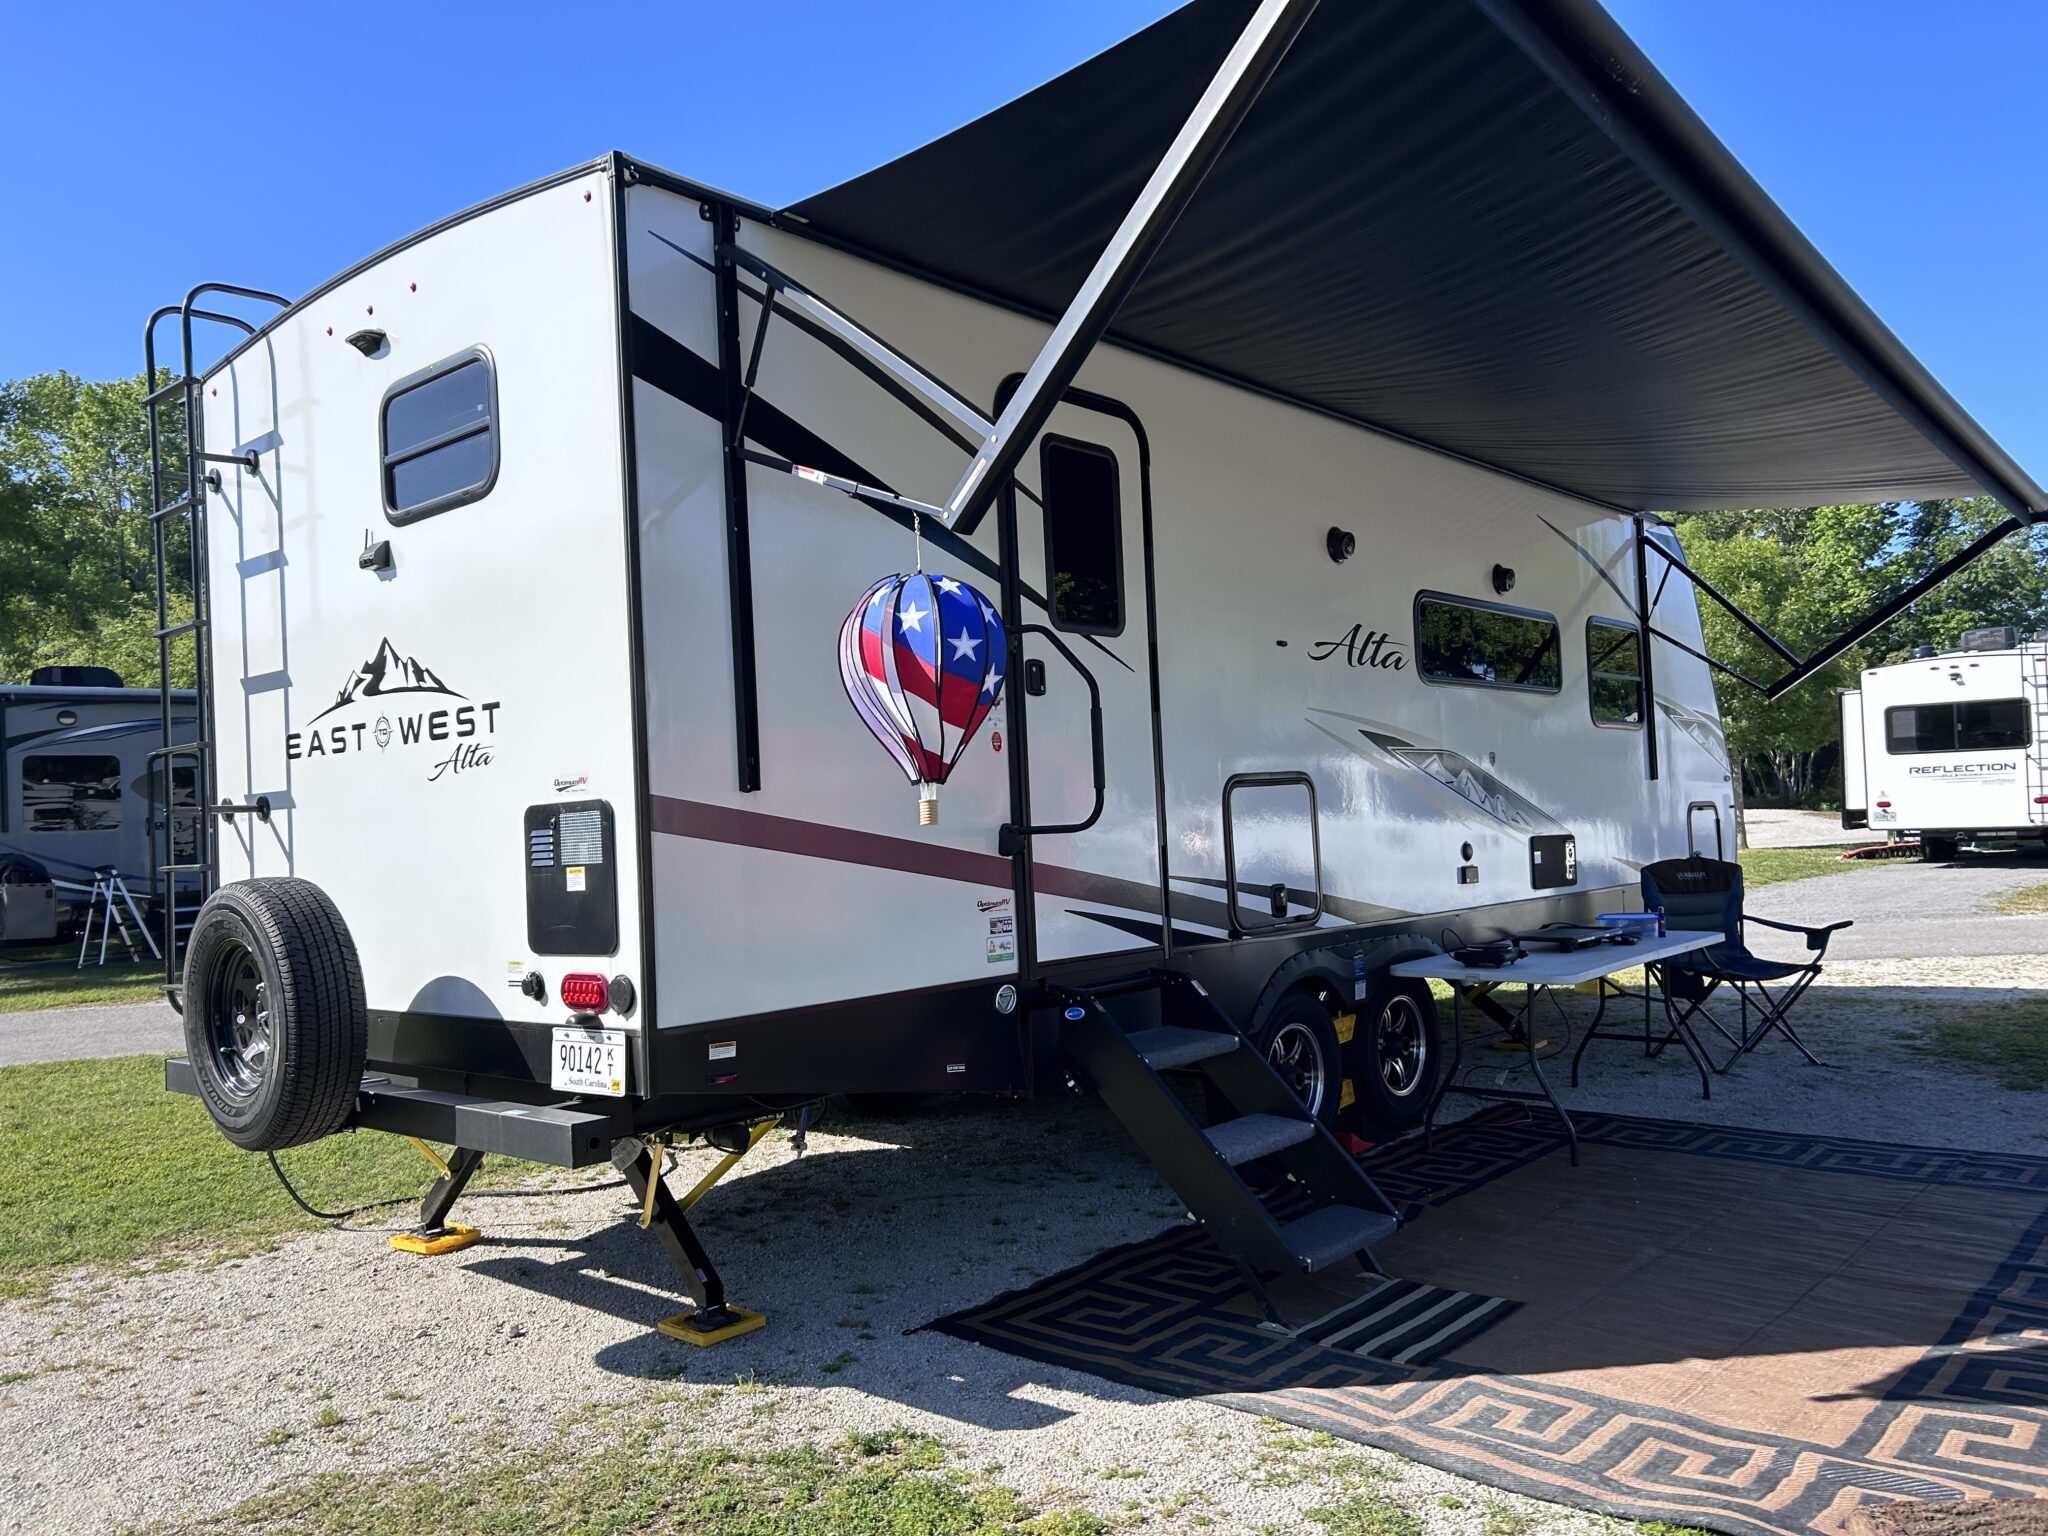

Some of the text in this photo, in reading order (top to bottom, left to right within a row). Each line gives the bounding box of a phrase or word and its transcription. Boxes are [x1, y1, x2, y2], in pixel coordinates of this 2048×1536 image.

[1307, 623, 1410, 671] Alta
[286, 722, 367, 760] EAST
[398, 701, 501, 745] WEST
[427, 743, 495, 782] Alta
[1909, 762, 2017, 775] REFLECTION
[560, 1044, 602, 1075] 90142
[568, 1076, 608, 1089] South Carolina
